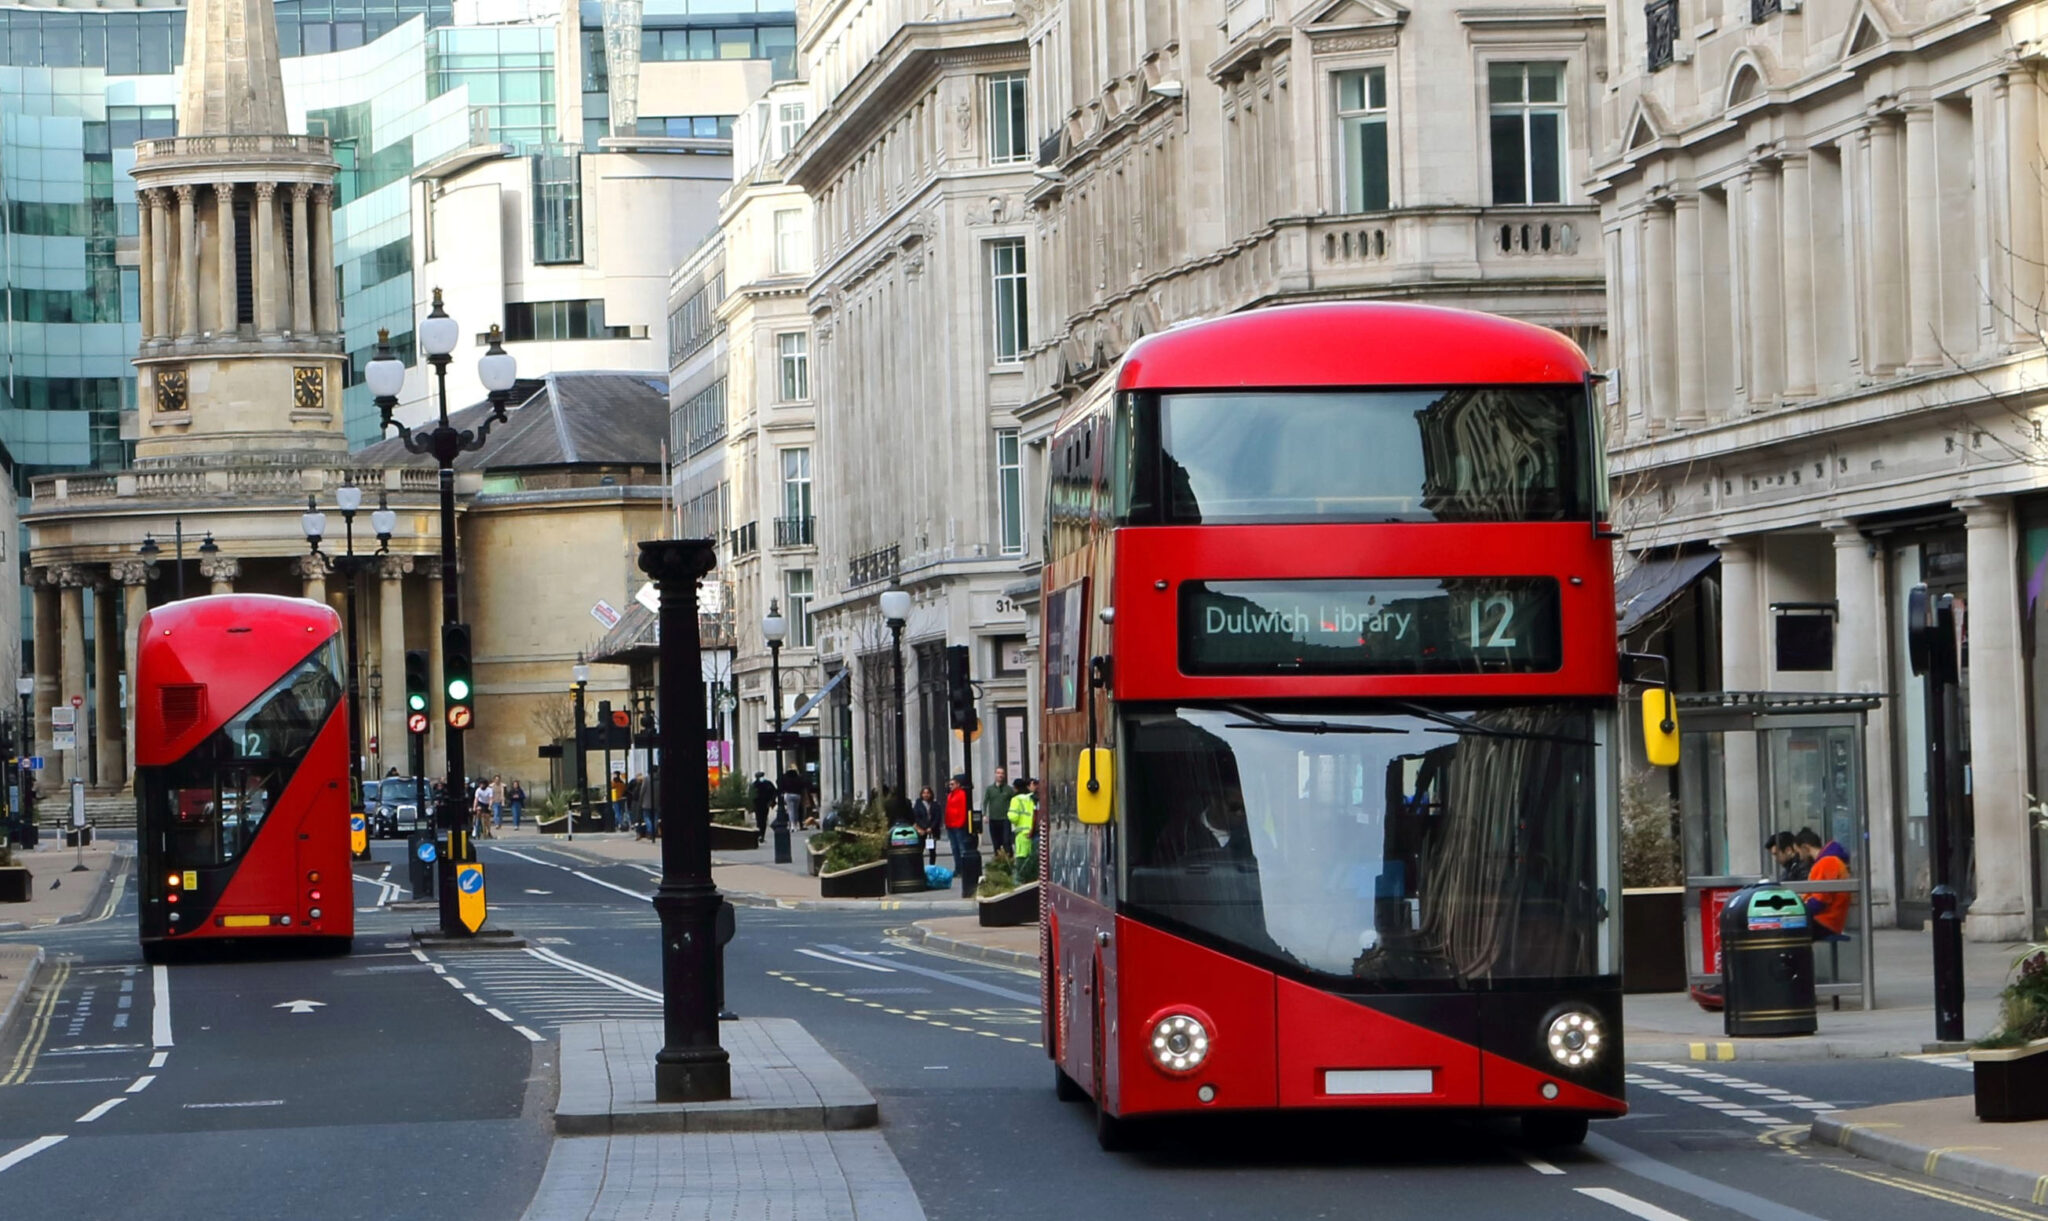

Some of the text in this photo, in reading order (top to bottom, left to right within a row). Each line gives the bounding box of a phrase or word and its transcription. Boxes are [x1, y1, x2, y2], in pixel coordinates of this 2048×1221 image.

[1206, 605, 1411, 640] Dulwich Library
[1470, 596, 1516, 648] 12
[241, 733, 262, 756] 12
